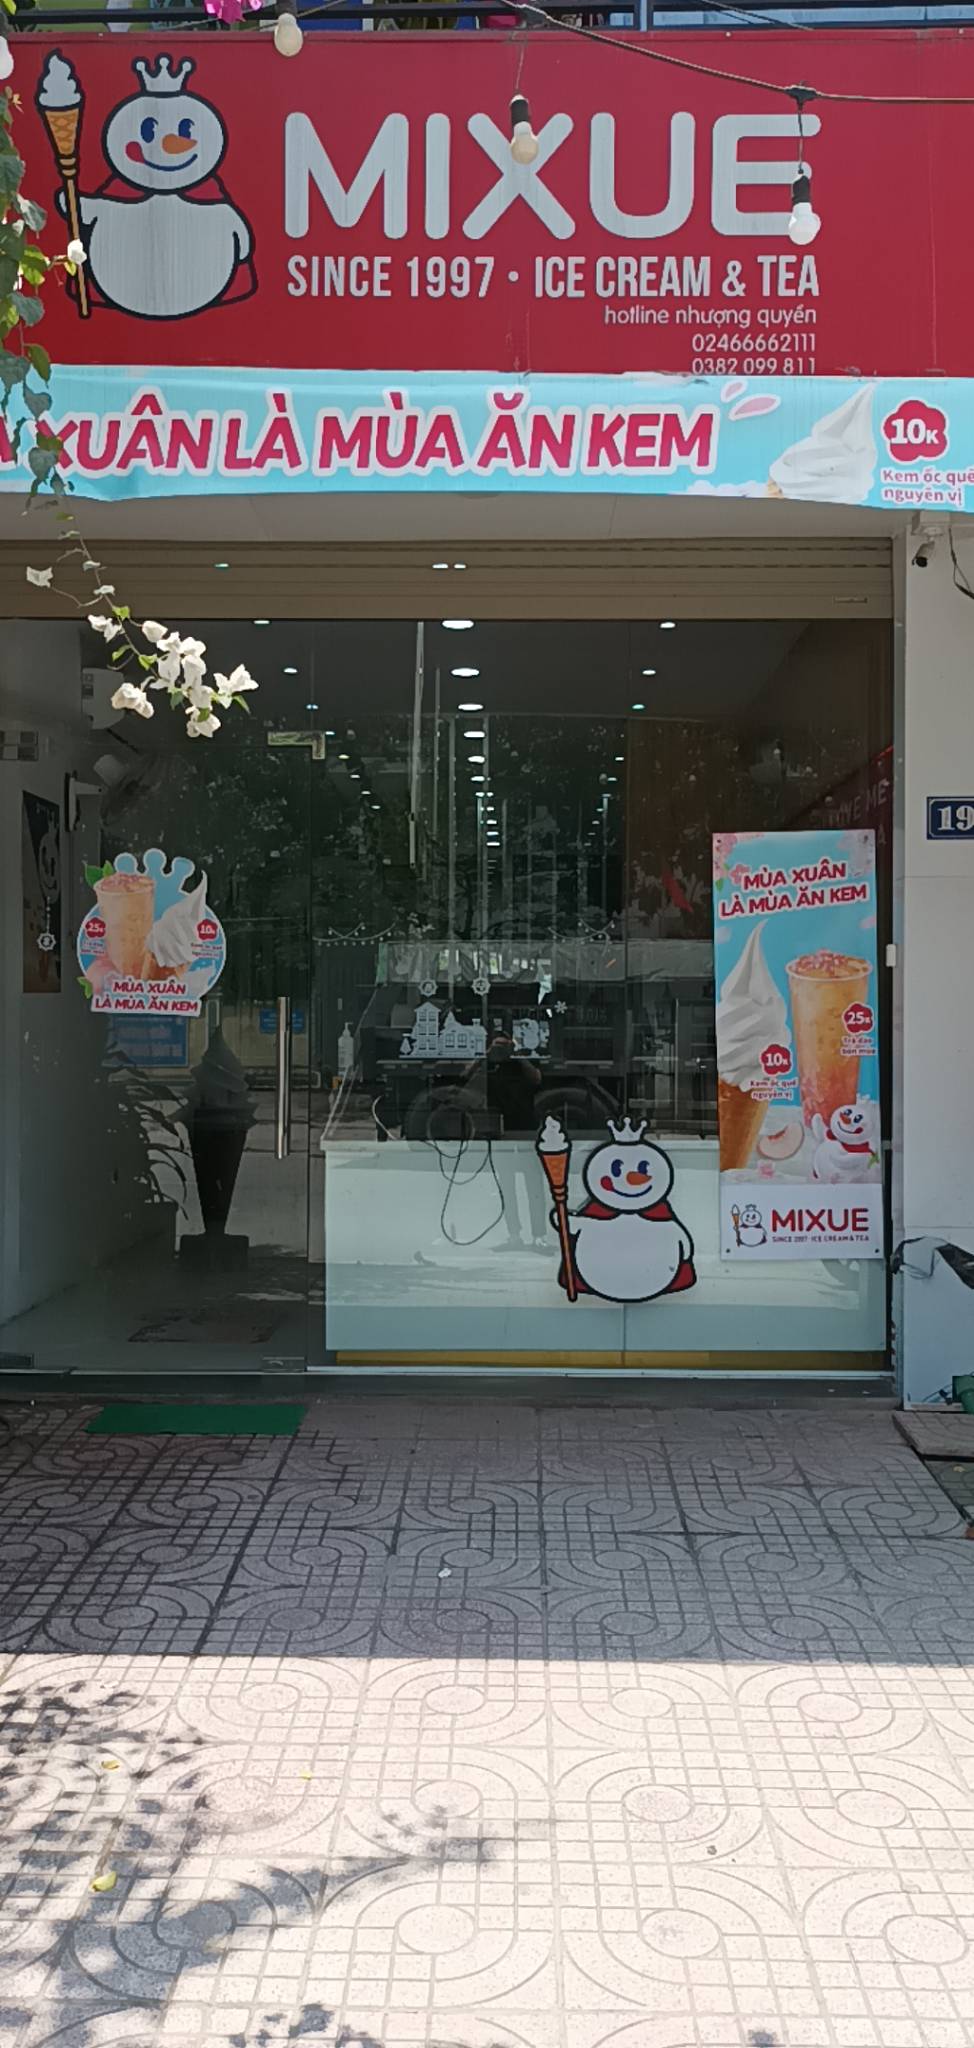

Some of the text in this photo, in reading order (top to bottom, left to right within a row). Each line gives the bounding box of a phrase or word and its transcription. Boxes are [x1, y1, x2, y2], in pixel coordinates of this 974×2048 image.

[285, 112, 821, 239] MIXUE
[287, 255, 819, 298] SINCE 1997 ICE CREAM & TEA
[604, 304, 669, 324] hotline
[675, 305, 750, 328] nhượng
[692, 333, 816, 352] 02466662111
[692, 357, 816, 375] 0382 099 811
[36, 393, 213, 470] XUÂN
[224, 393, 302, 469] LÀ
[319, 391, 464, 468] MÙA
[477, 392, 575, 468] ĂN
[587, 413, 713, 468] KEM
[883, 469, 919, 482] Kem
[743, 858, 846, 890] MÙA XUÂN
[721, 883, 867, 917] LÀ MÙA ĂN KEM
[113, 977, 186, 995] MÙA XUÂN
[95, 993, 198, 1012] LÀ MÙA ĂN KEM
[772, 1208, 869, 1232] MIXUE
